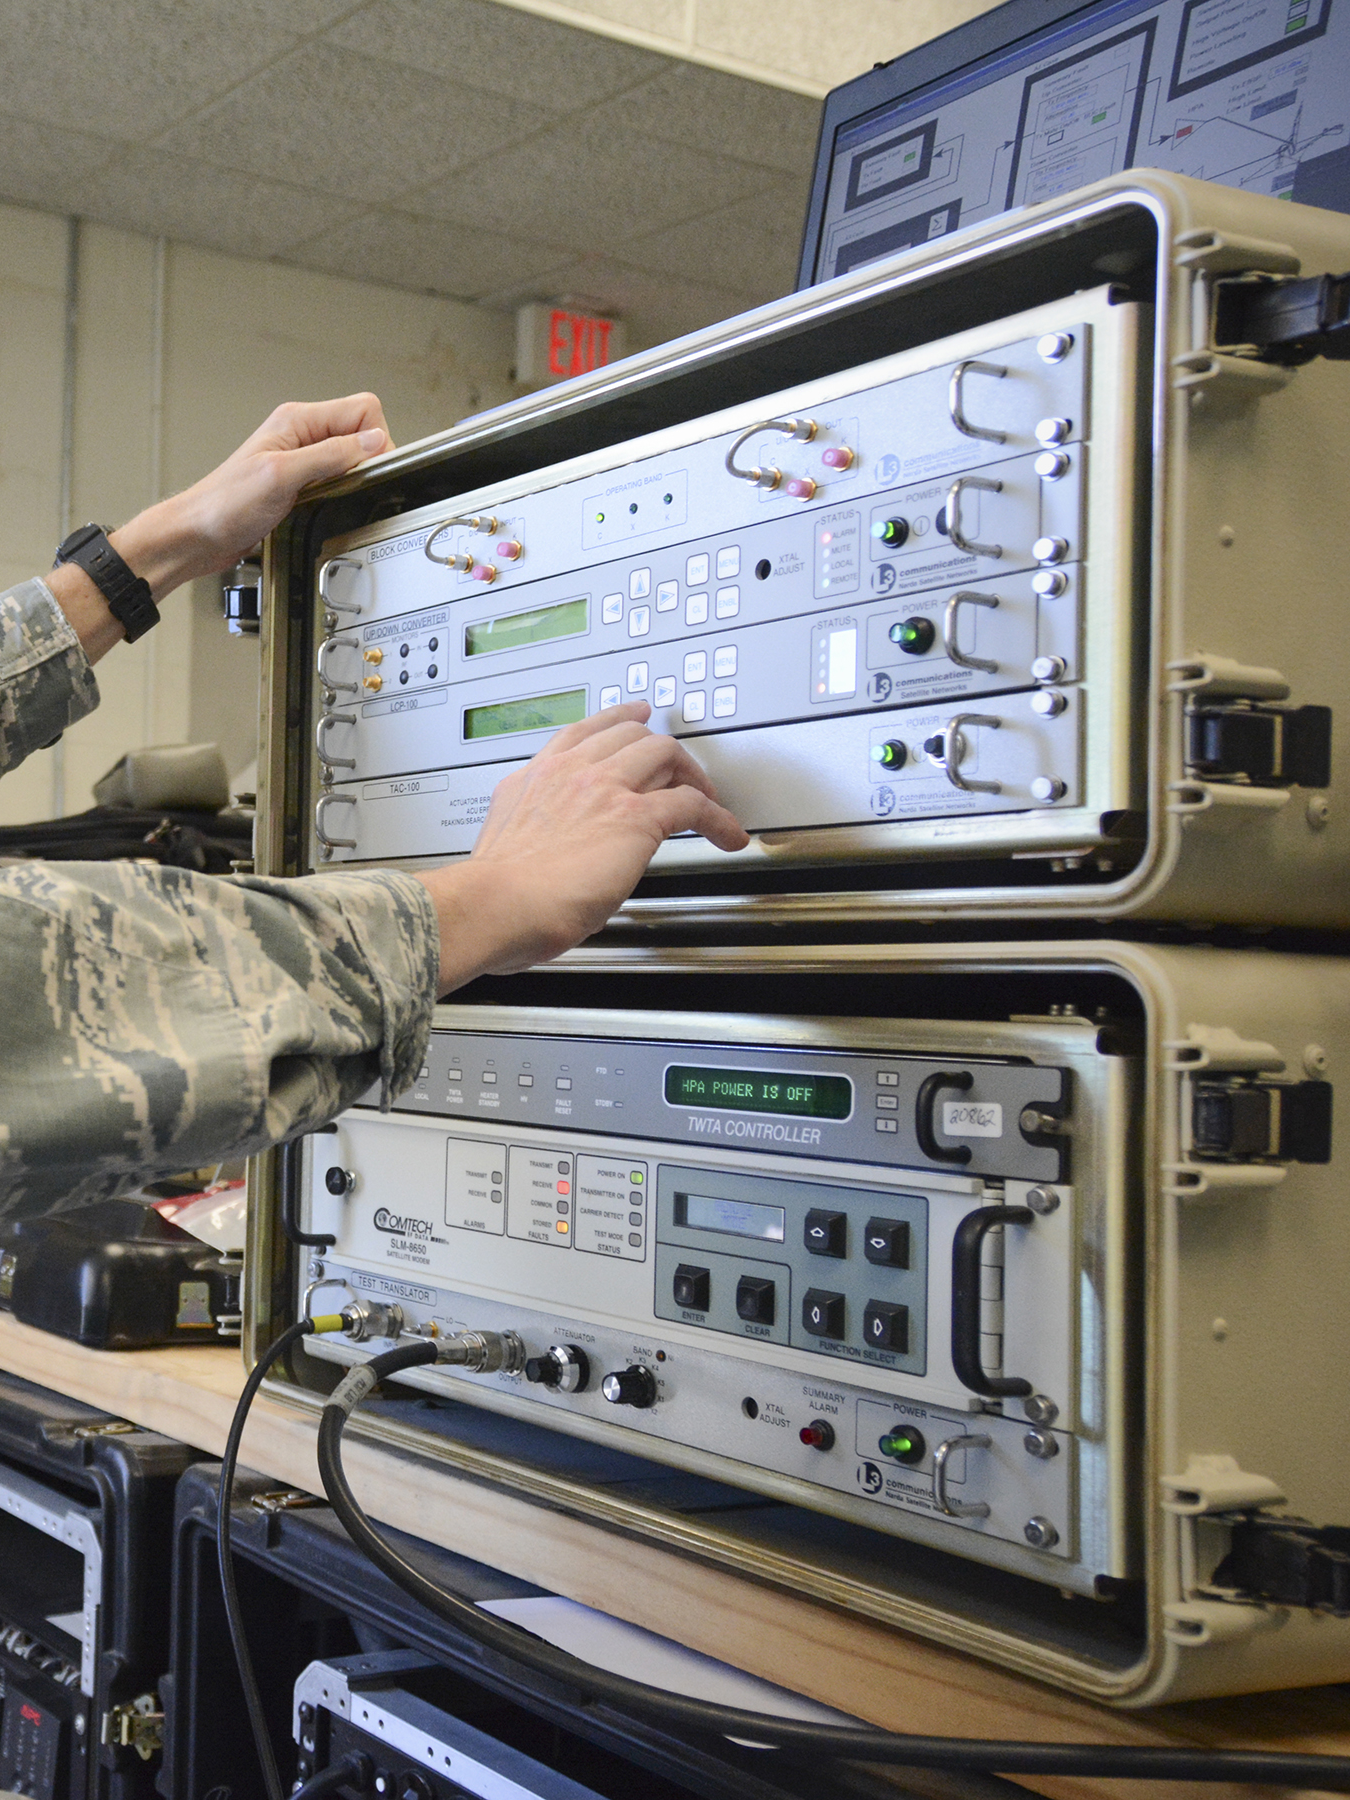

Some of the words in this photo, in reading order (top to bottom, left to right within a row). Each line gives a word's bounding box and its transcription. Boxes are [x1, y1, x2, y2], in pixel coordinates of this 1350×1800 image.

[549, 309, 613, 375] EXIT
[903, 441, 981, 467] communications
[605, 480, 643, 497] OPERATING
[644, 473, 663, 485] BAND
[905, 487, 942, 504] POWER
[820, 509, 855, 525] STATUS
[832, 528, 857, 539] ALARM
[370, 546, 396, 561] BLOCK
[831, 544, 852, 554] MUTE
[778, 552, 799, 564] XTAL
[831, 559, 854, 570] LOCAL
[690, 565, 705, 575] ENT
[718, 558, 738, 569] MENU
[772, 562, 805, 577] ADJUST
[899, 555, 978, 577] communications
[831, 572, 858, 584] REMOTE
[718, 597, 737, 609] ENBL
[902, 600, 938, 614] POWER
[366, 624, 400, 640] UP/DOWN
[401, 612, 447, 631] CONVERTER
[816, 616, 852, 630] STATUS
[687, 661, 703, 672] ENT
[715, 655, 736, 667] MENU
[895, 670, 973, 688] communications
[390, 699, 418, 712] LCP-100
[715, 696, 735, 707] ENBL
[906, 715, 940, 728] POWER
[390, 781, 420, 794] TAC-100
[449, 797, 479, 807] ACTUATOR
[479, 795, 492, 804] ERR
[441, 816, 485, 827] PEAKING/SEARC
[414, 1093, 430, 1101] LOCAL
[479, 1091, 499, 1100] HEATER
[682, 1079, 706, 1094] HPA
[712, 1081, 754, 1098] POWER
[762, 1084, 779, 1099] IS
[787, 1086, 814, 1102] OFF
[446, 1096, 464, 1104] POWER
[478, 1099, 500, 1108] STANDBY
[555, 1098, 572, 1107] FAULT
[555, 1107, 572, 1115] RESET
[687, 1116, 721, 1135] TWTA
[724, 1119, 822, 1145] CONTROLLER
[529, 1160, 554, 1169] TRANSMIT
[465, 1170, 488, 1179] TRANSMIT
[597, 1169, 616, 1178] POWER
[532, 1180, 553, 1190] RECEIVE
[468, 1189, 487, 1198] RECEIVE
[580, 1187, 616, 1199] TRANSMITTER
[530, 1199, 553, 1209] COMMON
[580, 1207, 603, 1217] CARRIER
[603, 1211, 624, 1221] DETECT
[373, 1207, 433, 1236] COMTECH
[463, 1219, 486, 1230] ALARMS
[532, 1219, 552, 1228] STORED
[414, 1233, 430, 1241] DATA
[527, 1230, 549, 1241] FAULTS
[594, 1230, 608, 1239] TEST
[608, 1233, 624, 1241] MODE
[390, 1238, 427, 1255] SLM-8650
[597, 1243, 621, 1254] STATUS
[386, 1250, 411, 1262] SATELLITE
[411, 1256, 431, 1265] MODEM
[358, 1276, 376, 1289] TEST
[380, 1281, 430, 1301] TRANSLATOR
[682, 1310, 706, 1323] ENTER
[553, 1327, 596, 1344] ATTENUATOR
[744, 1324, 771, 1337] CLEAR
[632, 1346, 653, 1357] BAND
[819, 1341, 862, 1358] FUNCTION
[863, 1350, 897, 1365] SELECT
[651, 1364, 660, 1372] K4
[802, 1386, 847, 1404] SUMMARY
[765, 1402, 786, 1416] XTAL
[809, 1401, 839, 1415] ALARM
[893, 1403, 928, 1419] POWER
[759, 1413, 792, 1429] ADJUST
